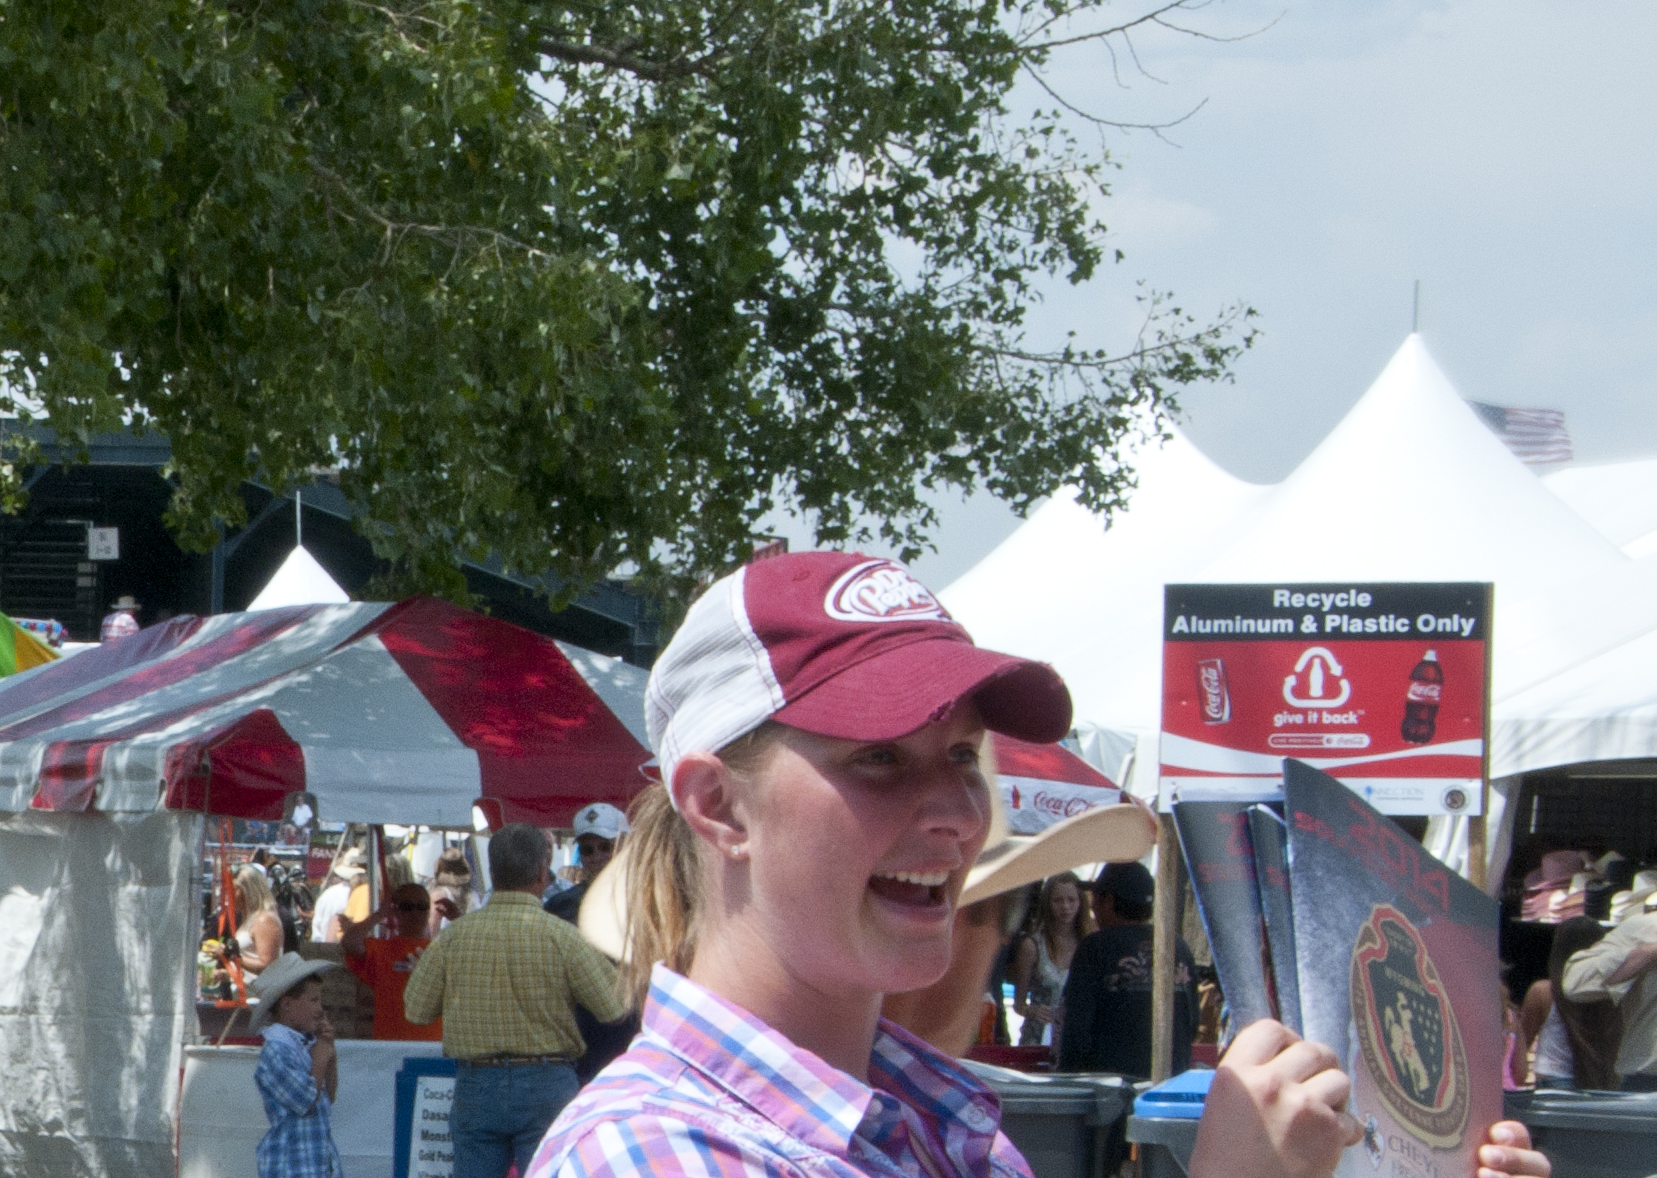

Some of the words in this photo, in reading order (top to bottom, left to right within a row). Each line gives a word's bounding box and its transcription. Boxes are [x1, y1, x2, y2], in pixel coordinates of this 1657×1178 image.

[1273, 589, 1372, 612] Recycle
[1172, 615, 1294, 634] Aluminum
[1300, 615, 1318, 633] &
[1325, 614, 1410, 632] Plastic
[1416, 614, 1476, 637] Only
[1273, 710, 1304, 727] give
[1307, 711, 1319, 724] it
